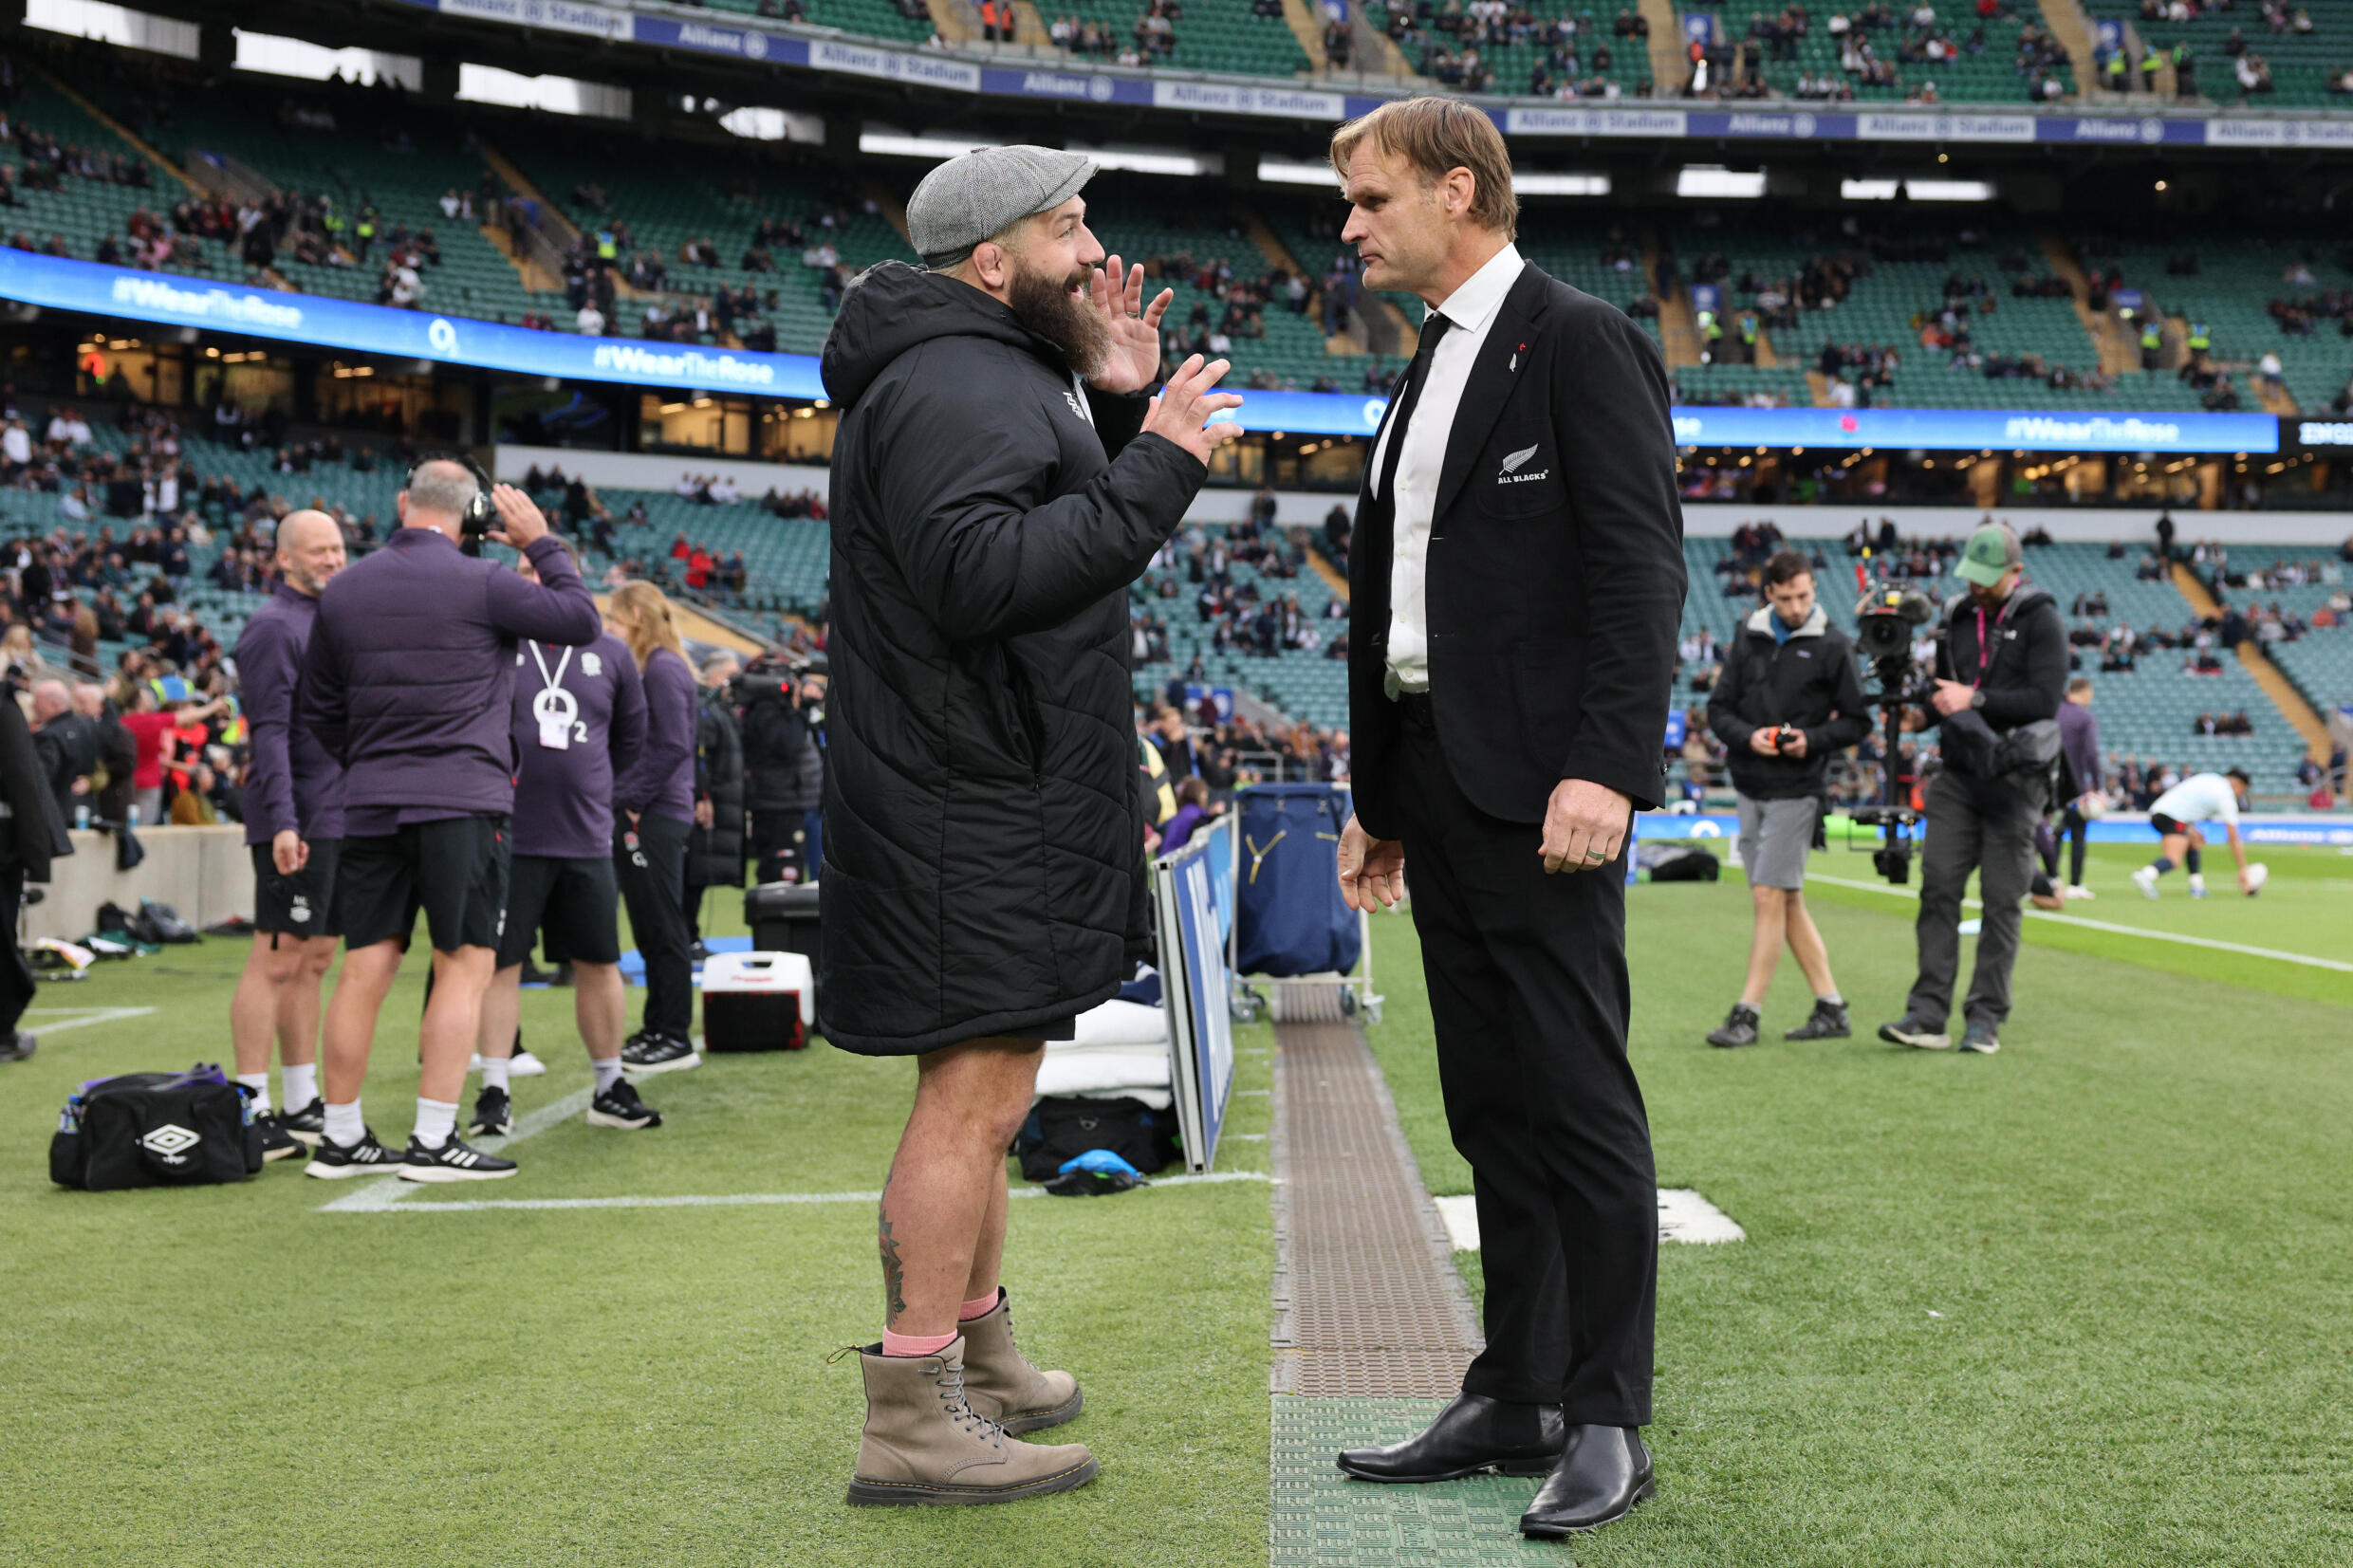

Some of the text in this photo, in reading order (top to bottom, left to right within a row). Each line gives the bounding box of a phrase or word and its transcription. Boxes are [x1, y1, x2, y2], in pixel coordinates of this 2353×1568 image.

[678, 23, 741, 52] Allianz
[821, 45, 973, 83] Allianz Stadium
[1023, 72, 1087, 96] Allianz
[1173, 85, 1327, 112] Allianz Stadium
[1520, 112, 1679, 130] Allianz Stadium
[1728, 114, 1790, 133] Allianz
[2075, 118, 2137, 139] Allianz
[593, 343, 775, 385] #WearTheRose
[1513, 472, 1547, 482] BLACKS
